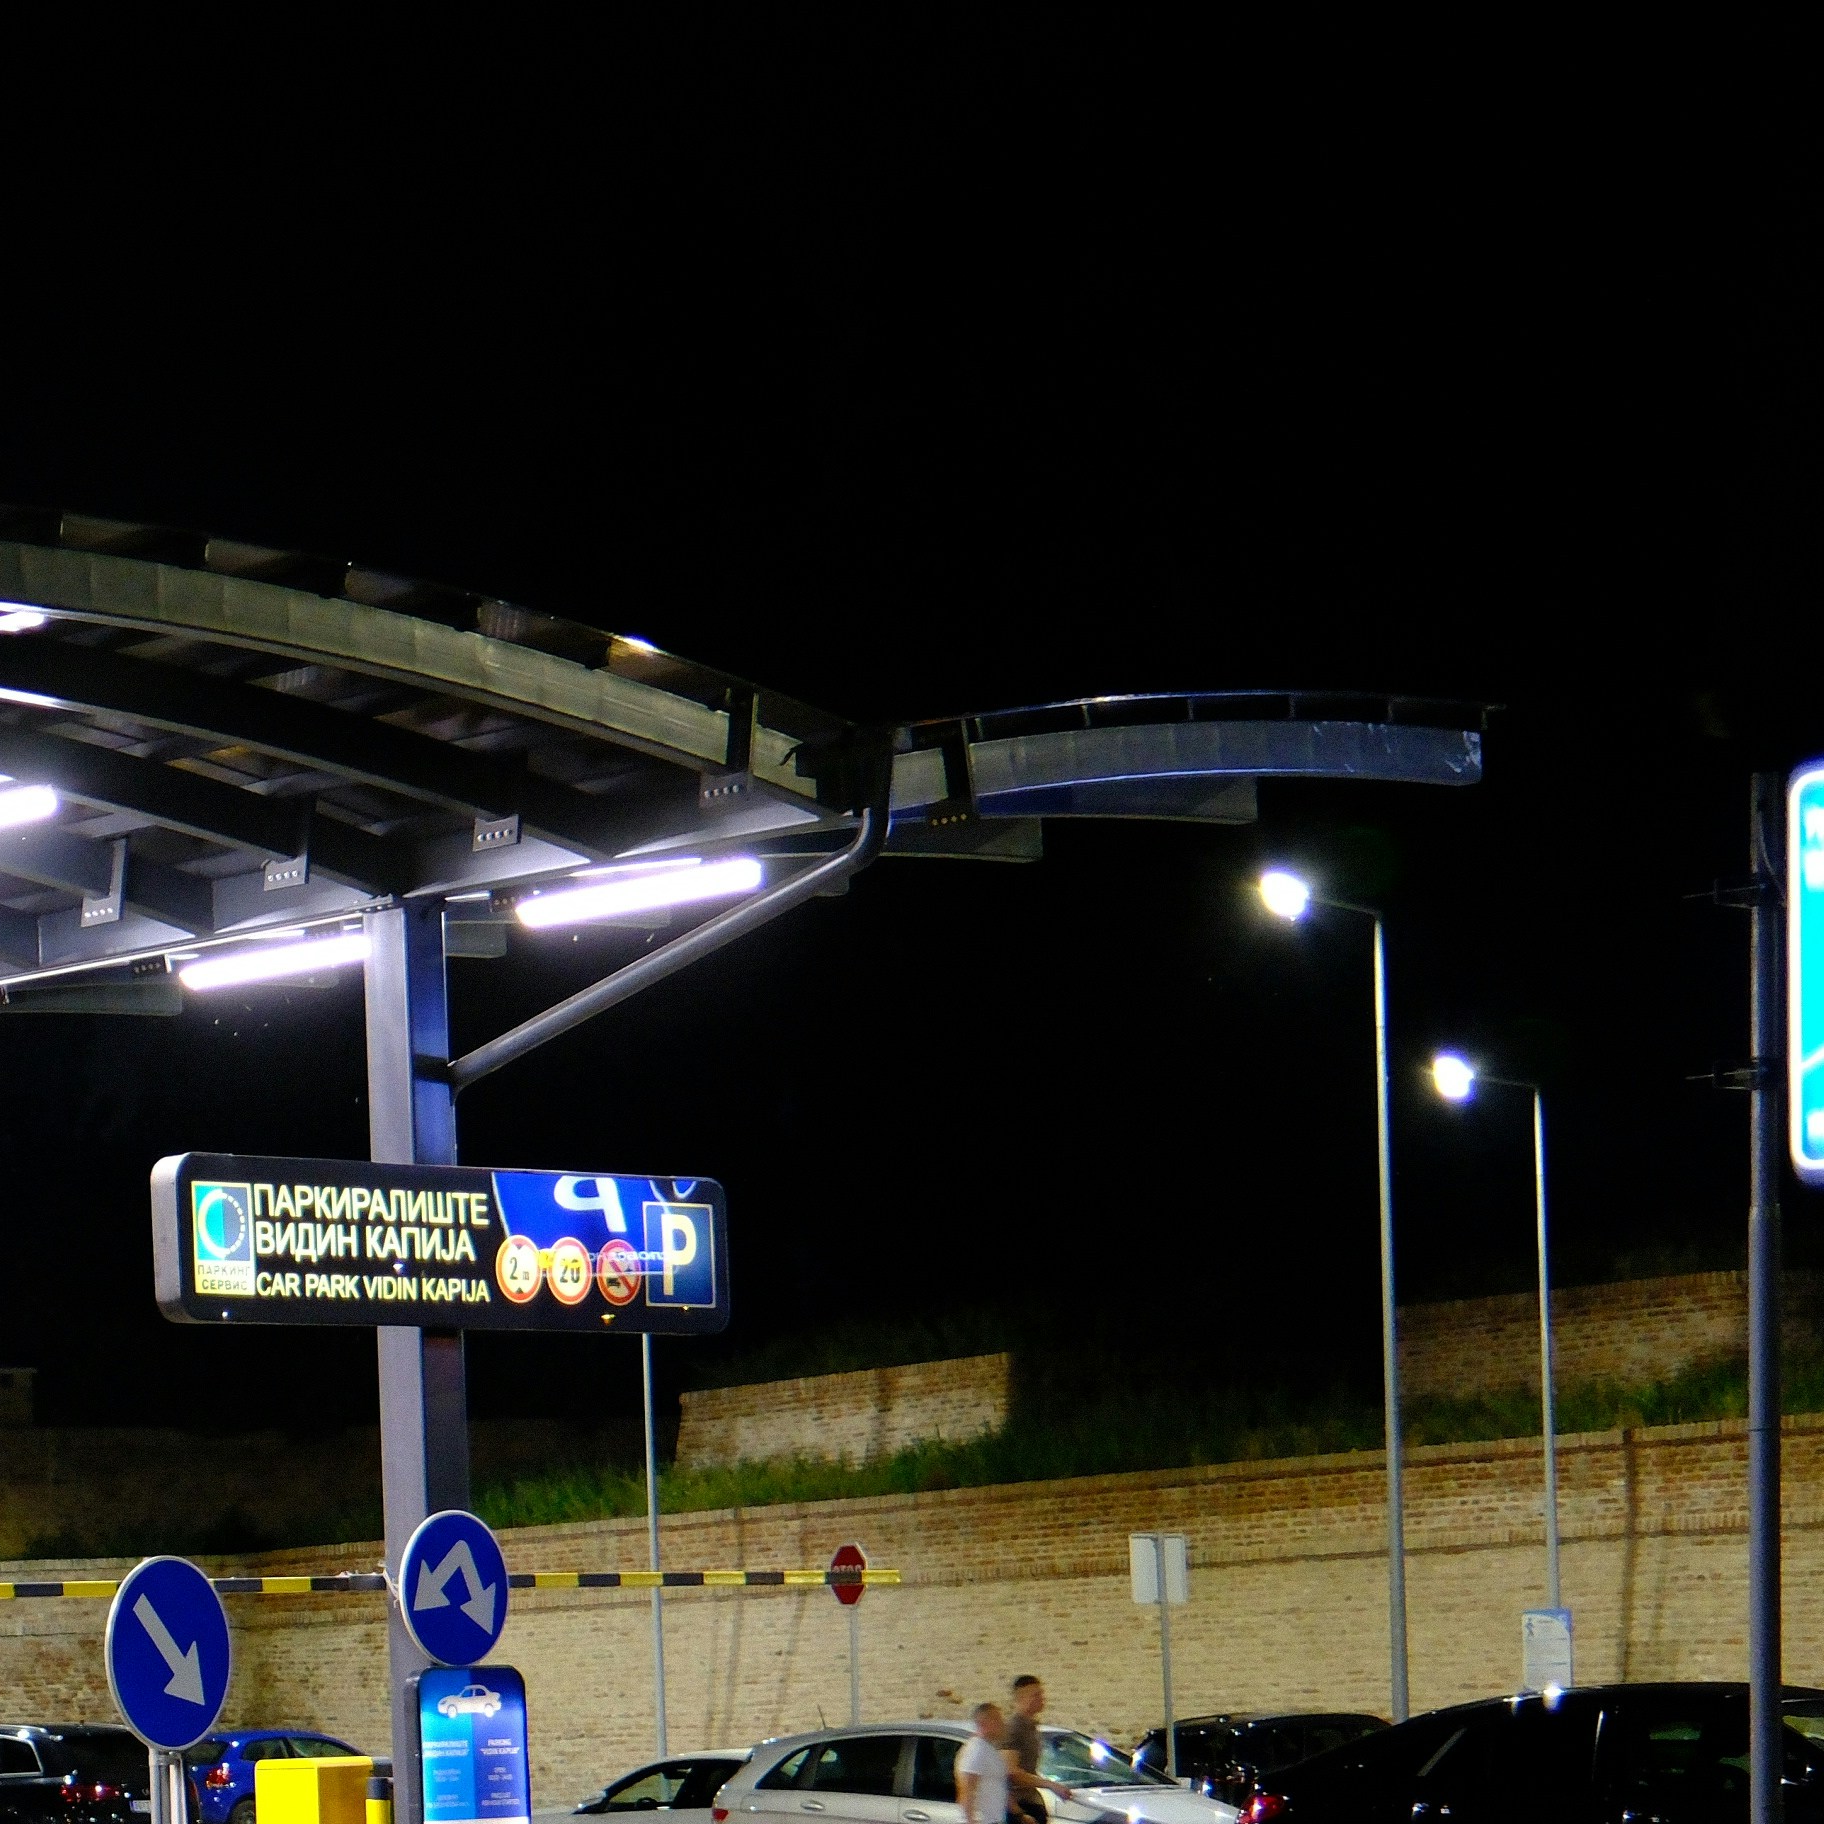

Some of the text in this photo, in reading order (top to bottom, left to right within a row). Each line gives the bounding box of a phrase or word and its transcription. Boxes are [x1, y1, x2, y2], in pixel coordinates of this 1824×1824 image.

[254, 1183, 490, 1226] ПАРКИРАЛИШТЕ
[256, 1221, 476, 1262] ВИДИН КАПИЈА
[661, 1213, 697, 1296] P
[197, 1264, 250, 1277] ПАРКИНГ
[202, 1279, 248, 1291] СЕРВИС
[559, 1259, 581, 1284] 20
[256, 1272, 490, 1303] CAR PARK VIDIN KAPIJA
